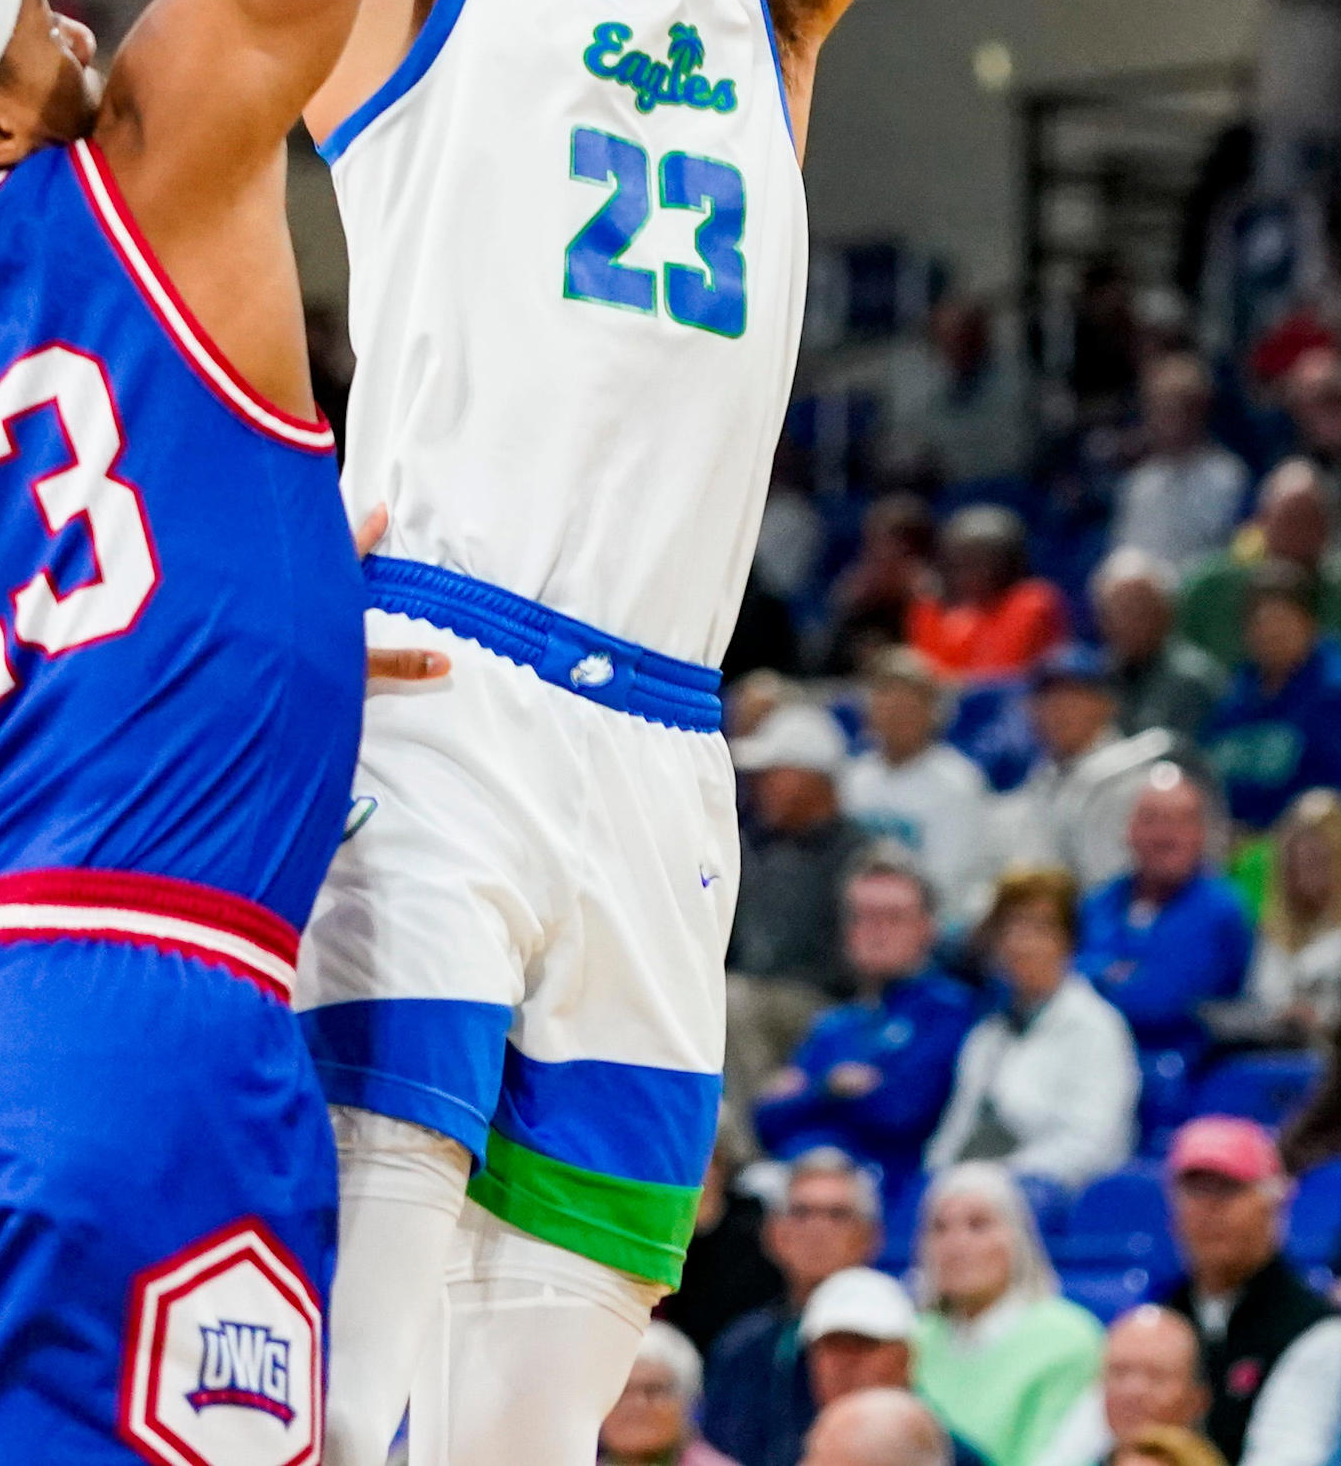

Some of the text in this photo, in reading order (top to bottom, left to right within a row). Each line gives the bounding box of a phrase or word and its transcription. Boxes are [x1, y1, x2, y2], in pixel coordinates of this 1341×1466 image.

[583, 20, 739, 114] Eagles
[562, 124, 748, 340] 23
[197, 1319, 291, 1406] UWG
